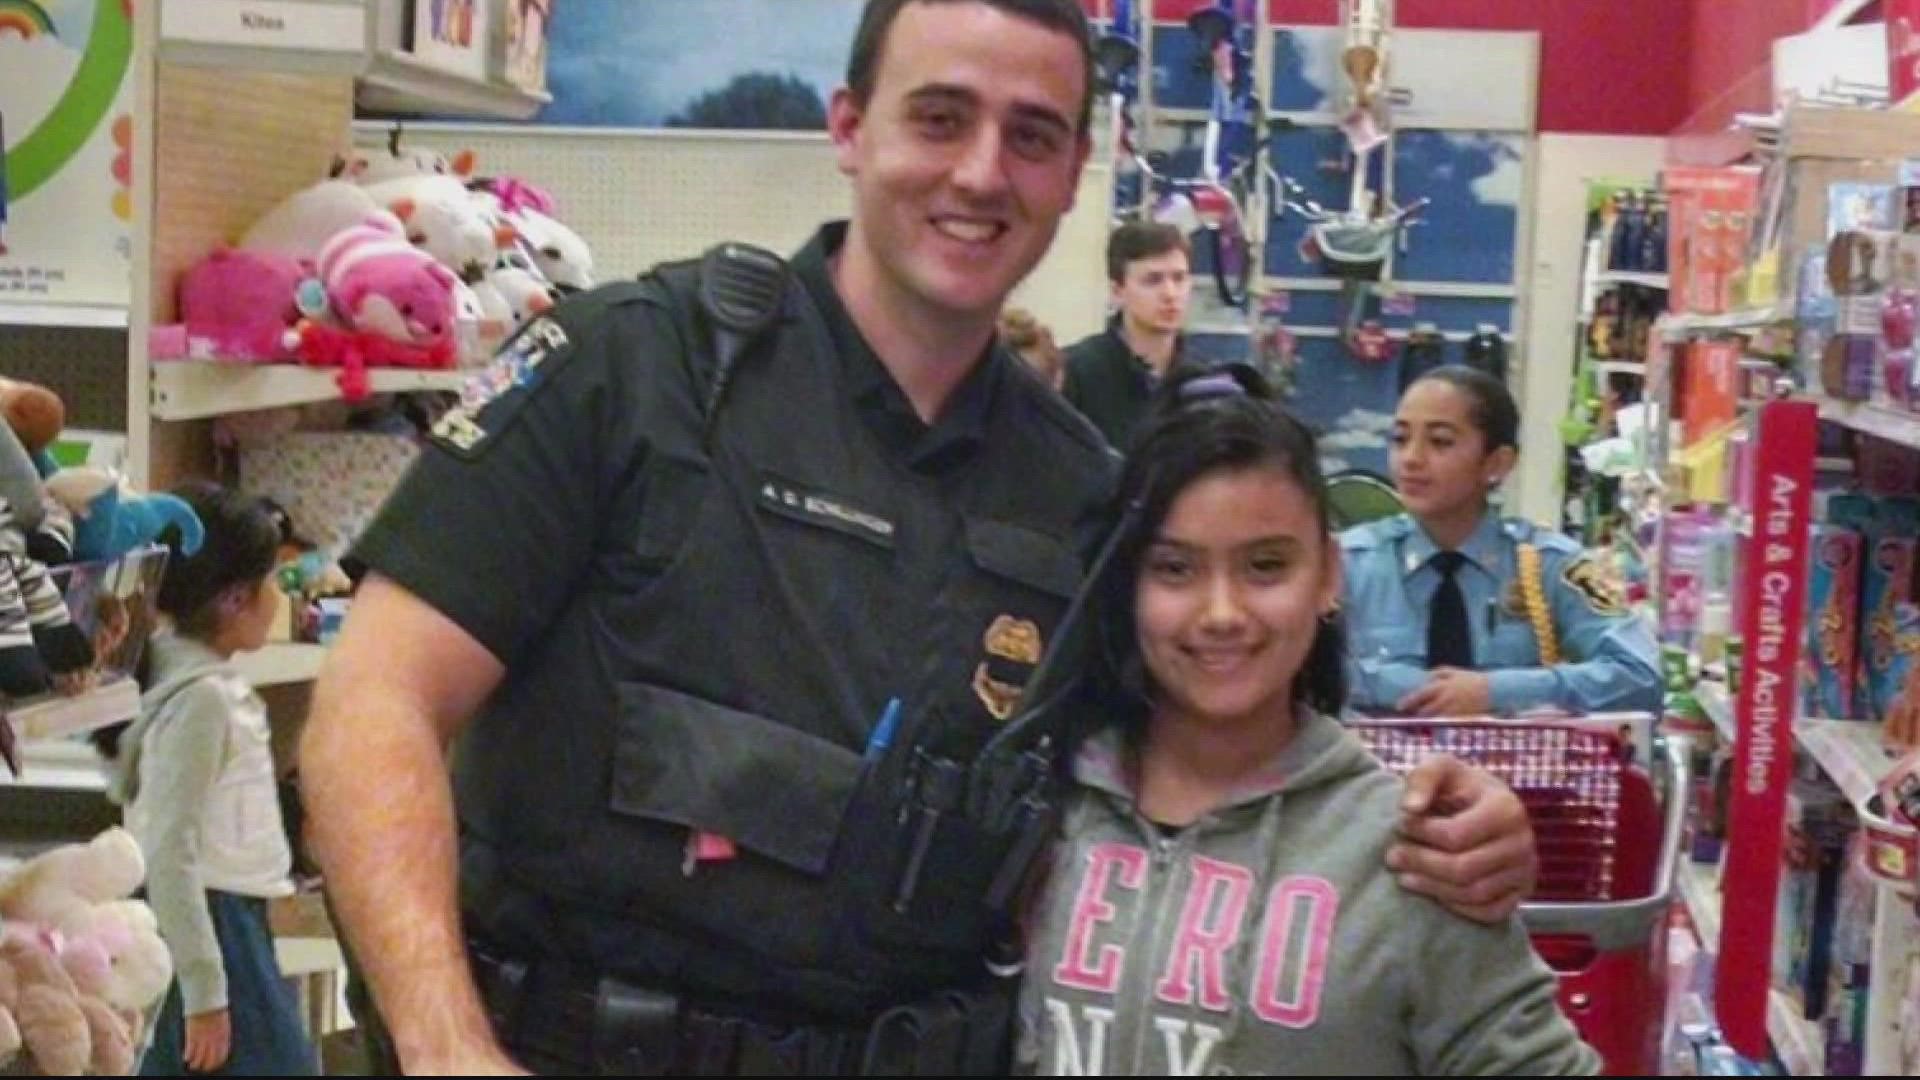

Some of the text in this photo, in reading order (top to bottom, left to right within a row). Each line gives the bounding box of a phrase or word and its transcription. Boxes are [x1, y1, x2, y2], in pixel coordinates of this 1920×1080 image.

[1747, 473, 1798, 795] Arts & Crafts Activities
